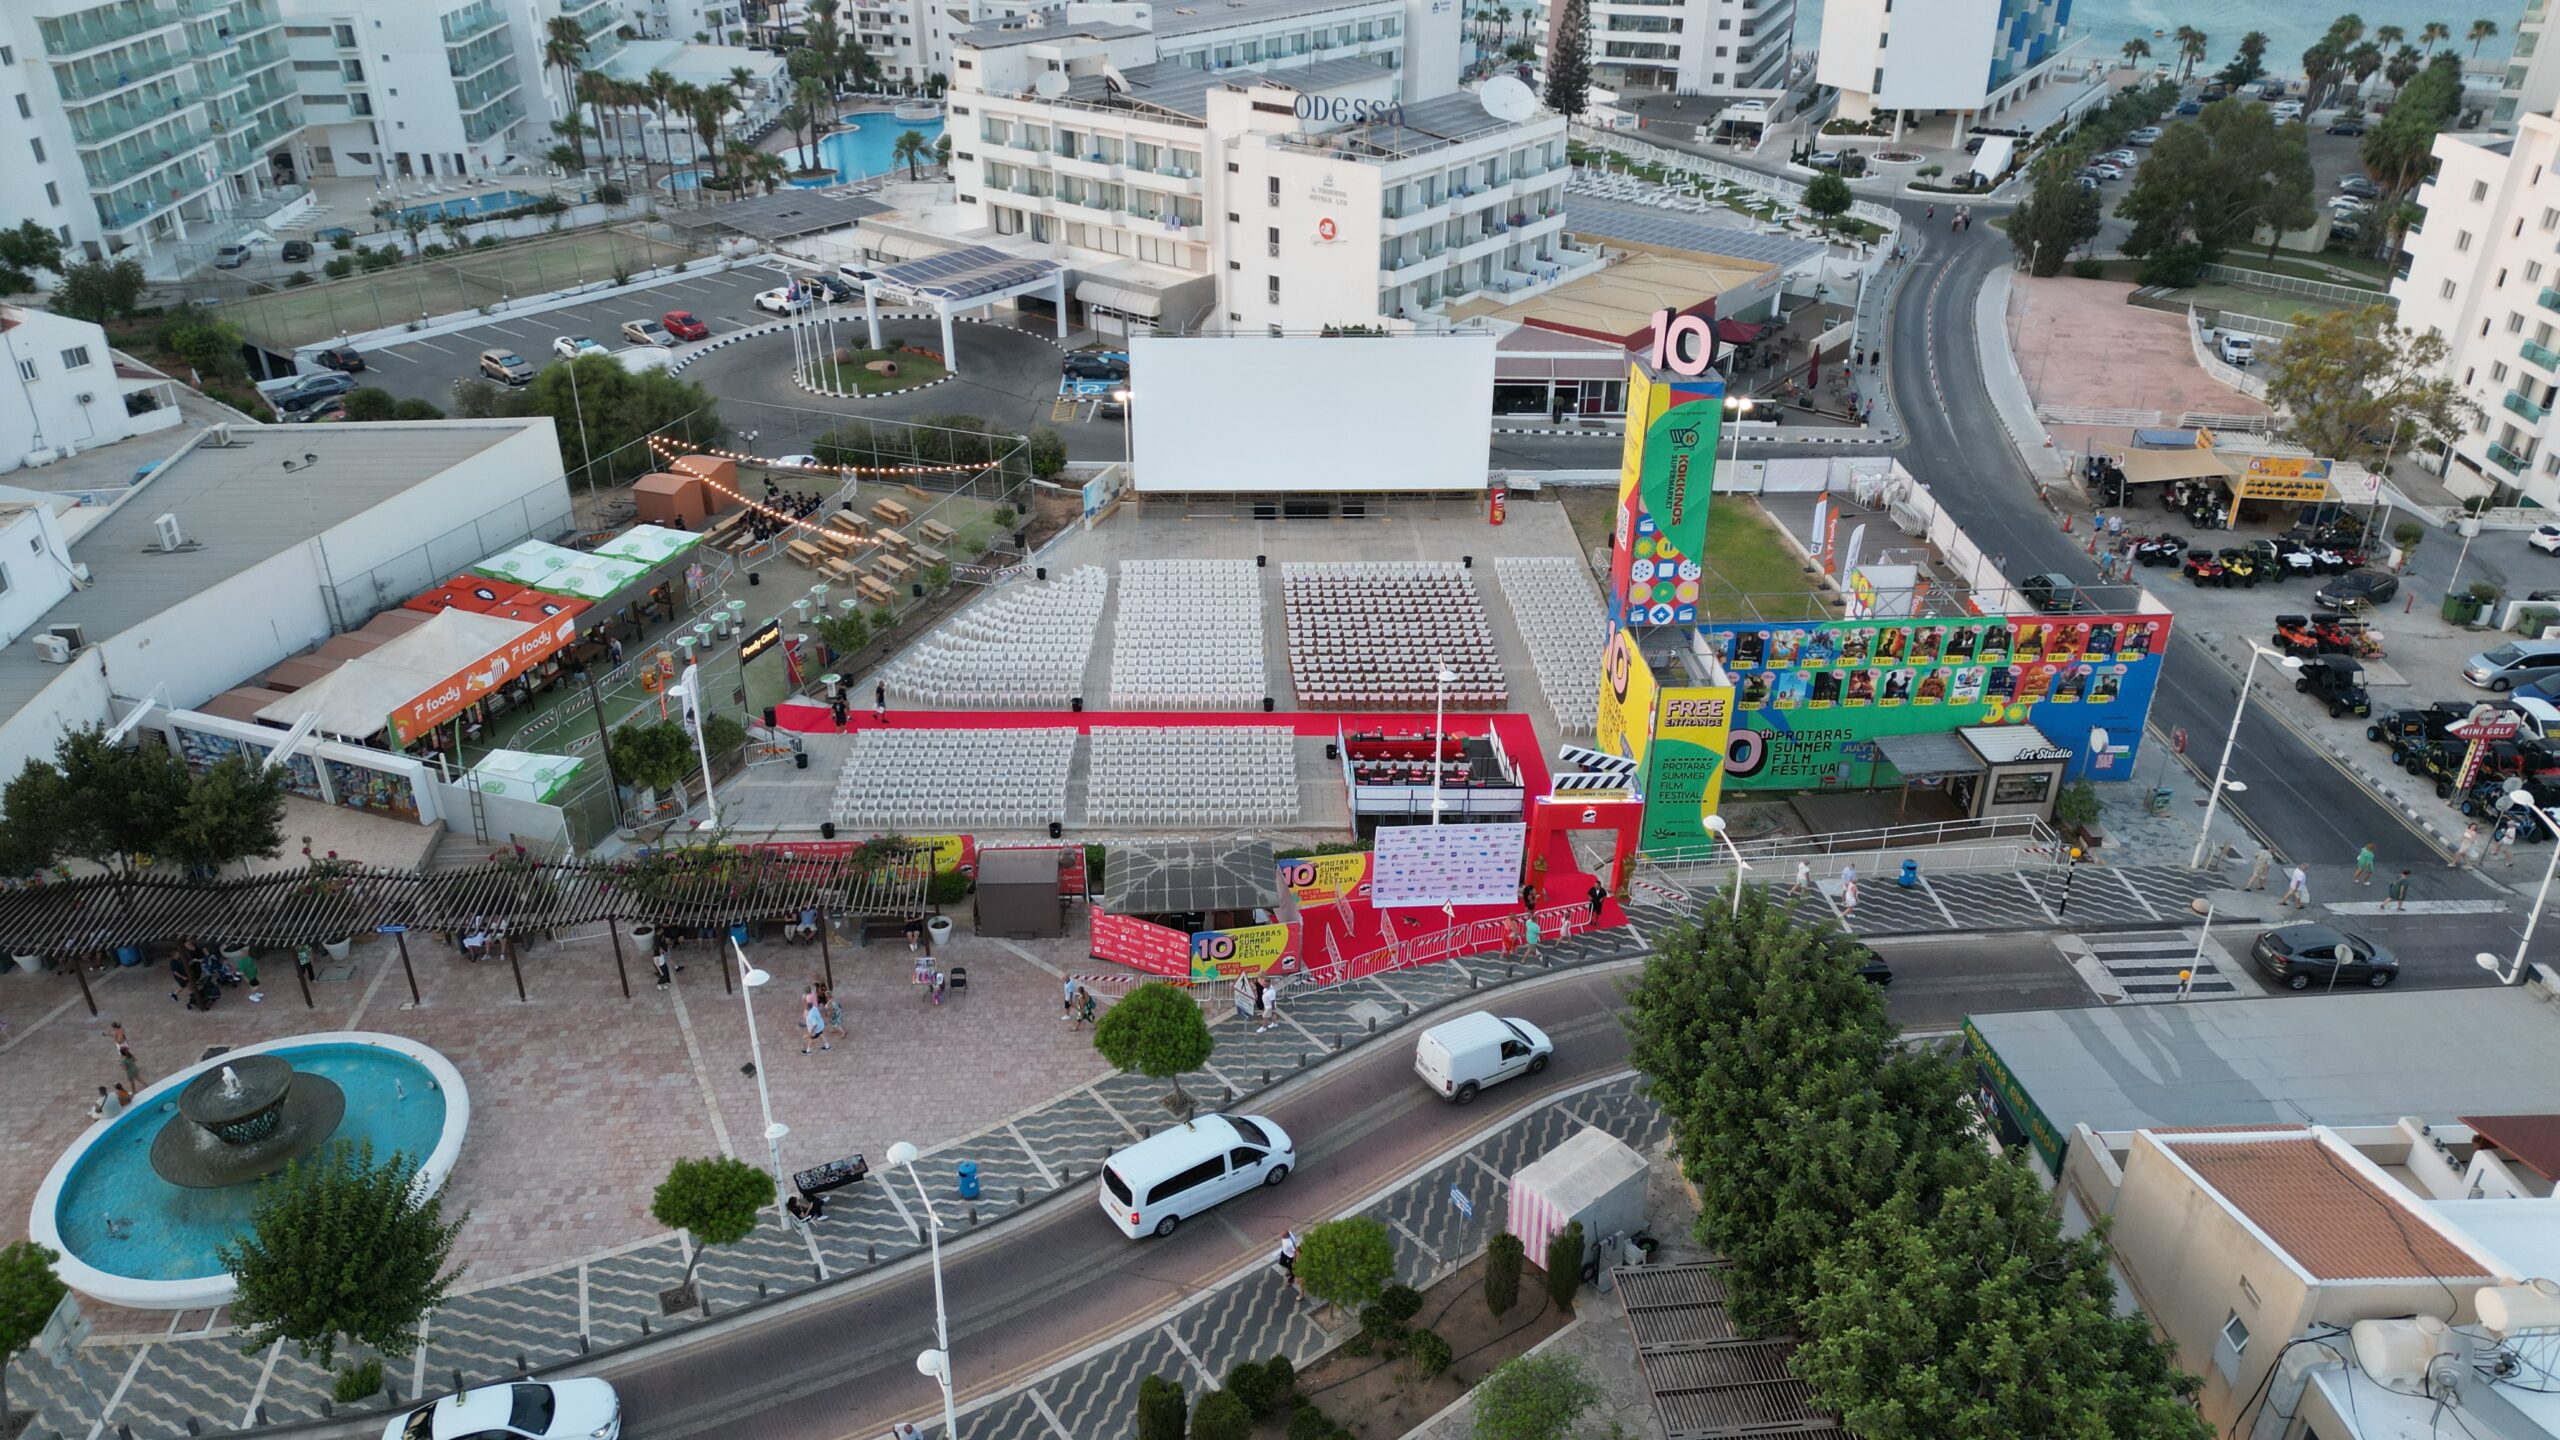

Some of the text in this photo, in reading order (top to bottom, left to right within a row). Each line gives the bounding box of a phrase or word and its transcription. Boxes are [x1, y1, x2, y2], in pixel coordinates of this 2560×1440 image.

[1651, 309, 1713, 376] 10
[1665, 455, 1678, 510] SUPERMARKET
[1672, 454, 1689, 526] KOKKINOS
[522, 630, 552, 655] foody
[426, 686, 460, 713] foody
[1666, 700, 1726, 718] FREE
[1664, 718, 1723, 728] ENTRANCE
[1776, 729, 1852, 741] PROTARAS
[1774, 742, 1832, 753] SUMMER
[1843, 744, 1868, 752] JULY
[2474, 739, 2484, 762] LUNA
[1772, 754, 1811, 764] FILM
[2016, 748, 2073, 760] Art Studio
[1662, 772, 1705, 780] SUMMER
[1660, 782, 1684, 790] FILM
[1659, 791, 1700, 800] FESTIVAL
[1320, 859, 1359, 867] PROTARAS
[1240, 930, 1281, 939] PROTARAS
[1239, 938, 1271, 946] SUMMER
[1239, 949, 1279, 959] FESTIVAL
[1966, 1024, 2007, 1086] PROTARAS
